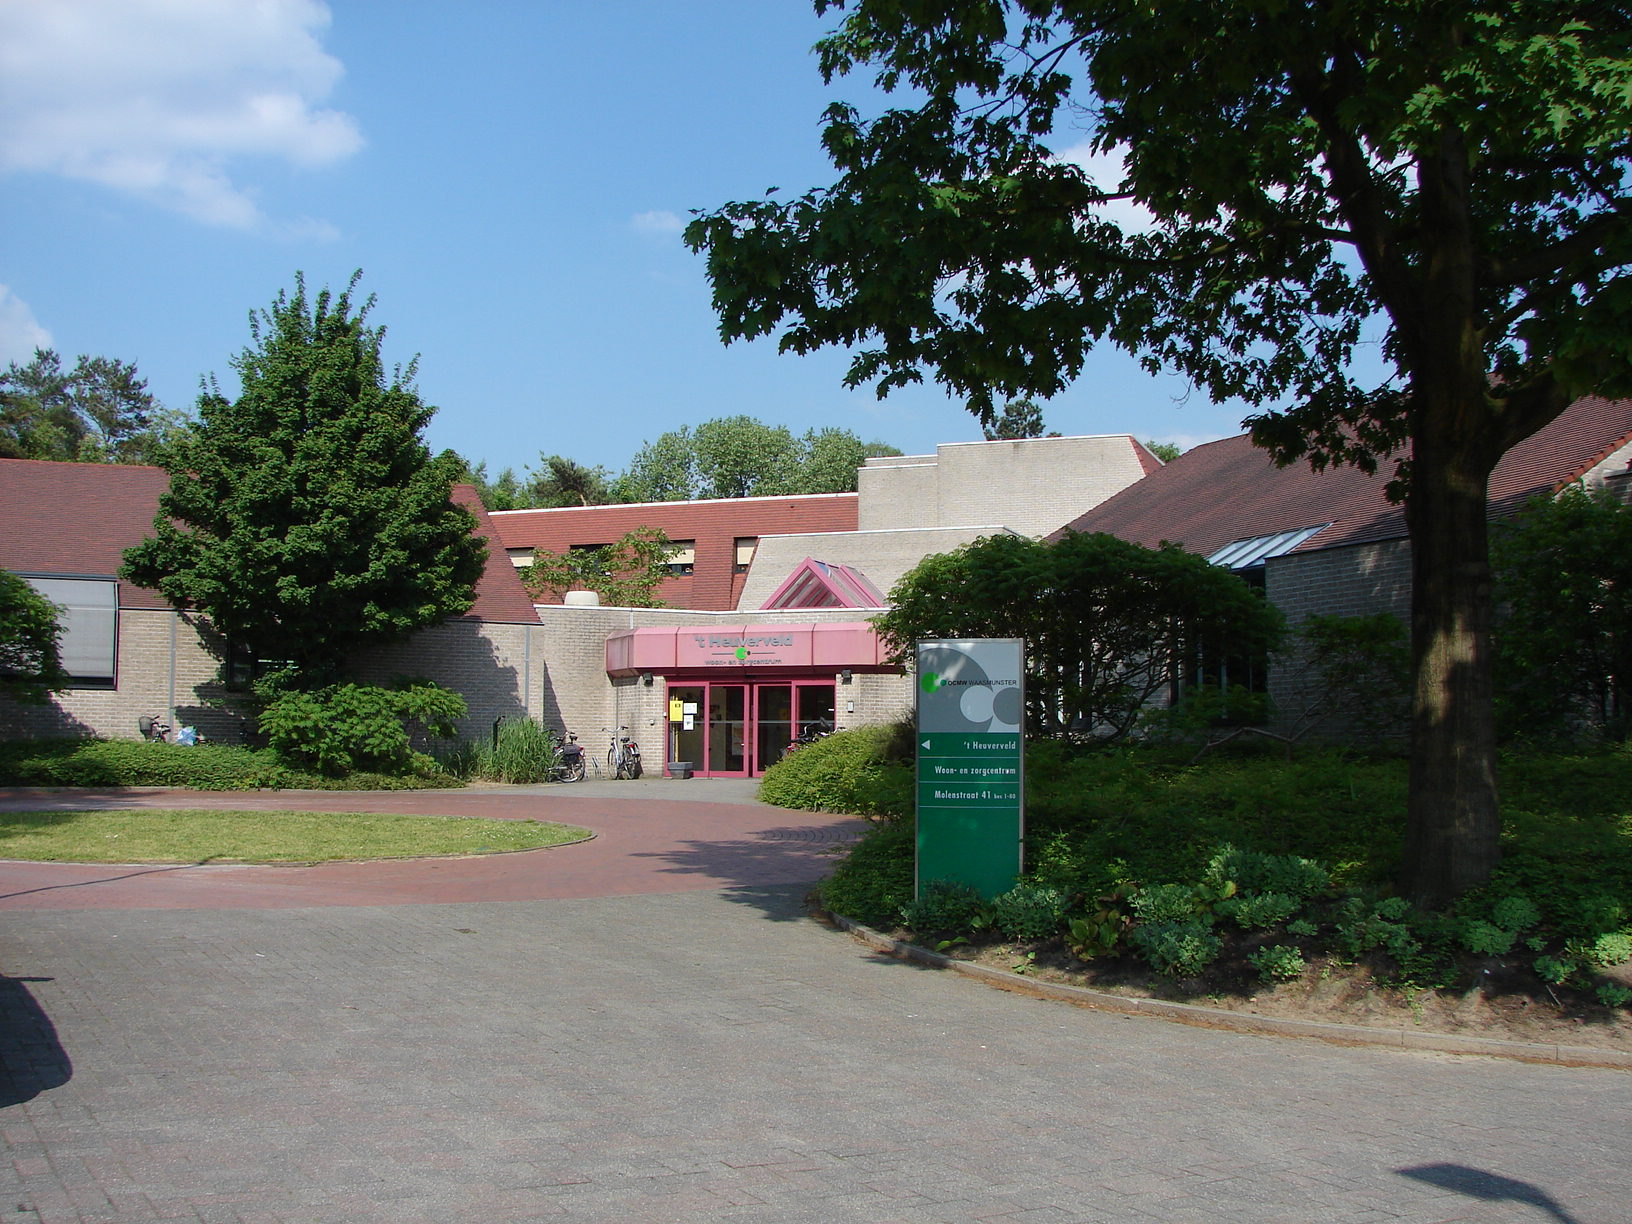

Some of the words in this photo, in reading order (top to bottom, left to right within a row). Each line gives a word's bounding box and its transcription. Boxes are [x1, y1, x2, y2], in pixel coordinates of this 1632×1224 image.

[709, 634, 793, 648] Heuverveld
[972, 741, 1016, 749] Heuverveld
[934, 765, 957, 774] Woon-
[970, 767, 1016, 776] zorgcentrum
[934, 790, 979, 799] Molenstraat
[981, 791, 991, 799] 41
